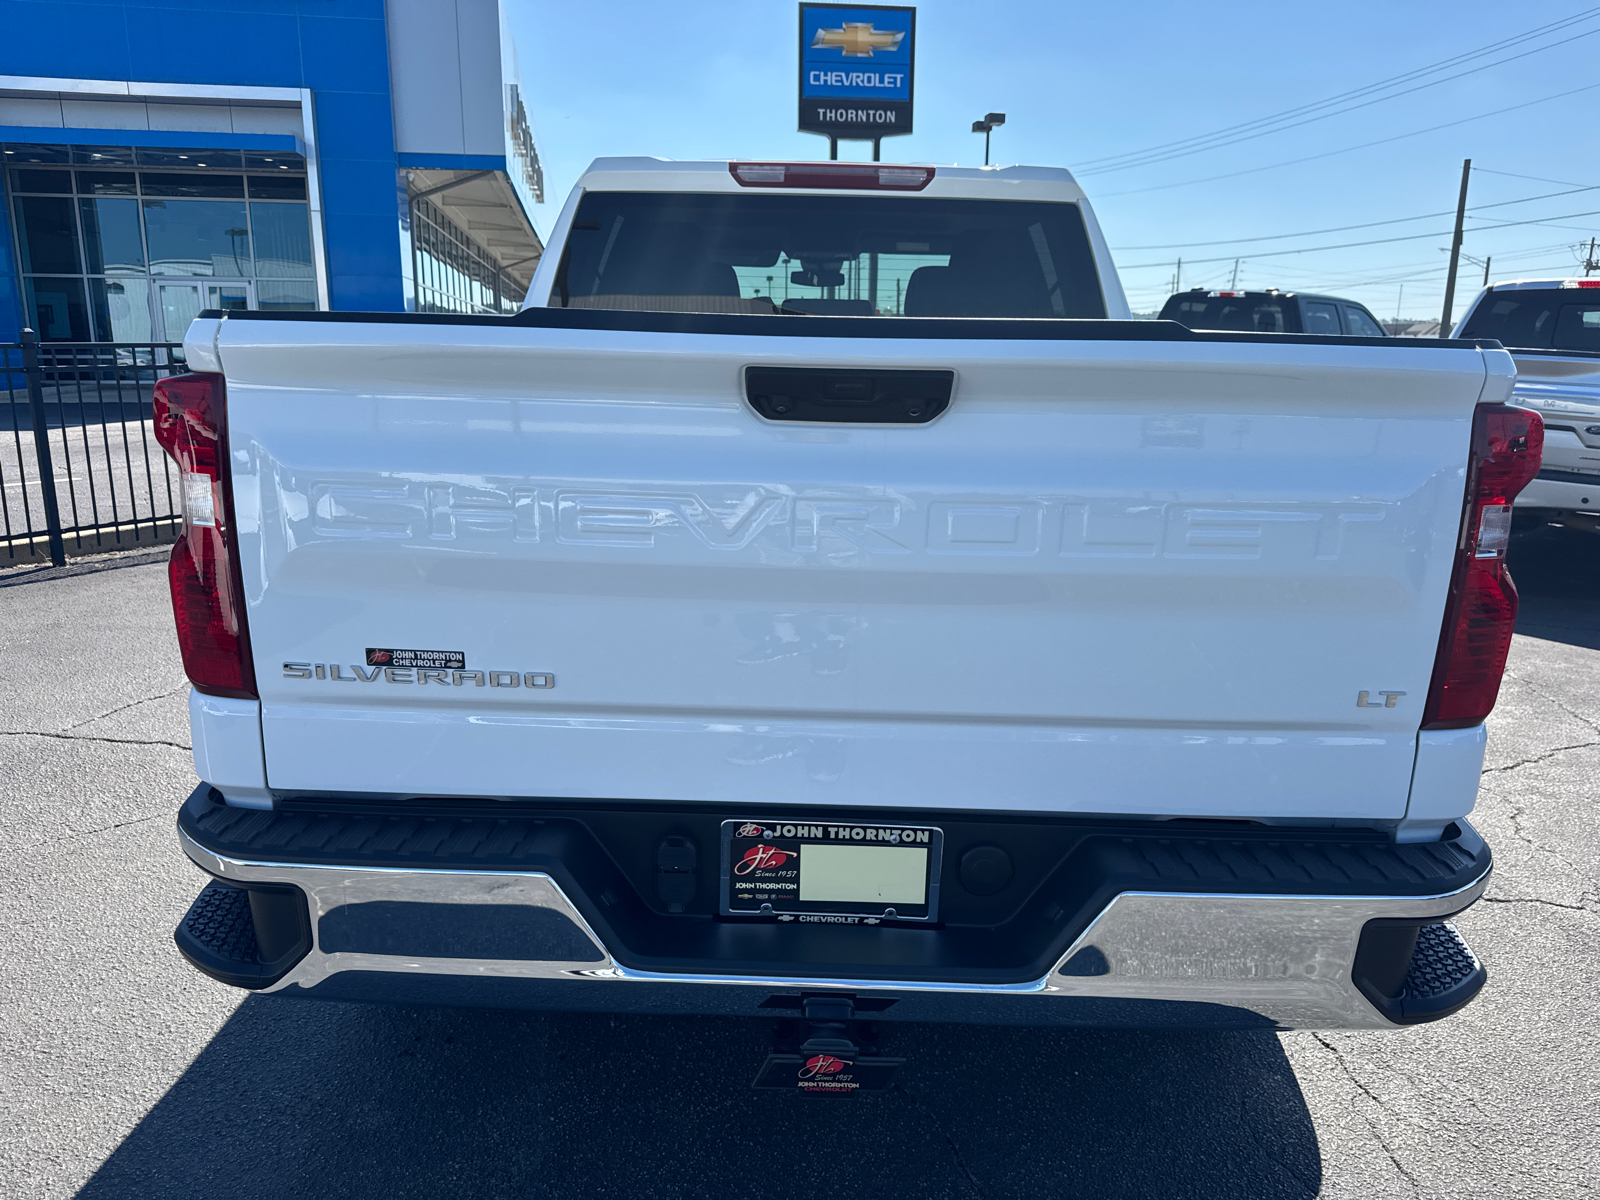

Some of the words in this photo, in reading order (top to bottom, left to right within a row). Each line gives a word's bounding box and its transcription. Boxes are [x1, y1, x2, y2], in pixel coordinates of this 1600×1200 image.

[809, 71, 904, 88] CHEVROLET
[817, 108, 896, 123] THORNTON
[311, 478, 1386, 561] CHEVROLET
[393, 651, 415, 659] JOHN
[417, 652, 463, 660] THORNTON
[393, 659, 446, 667] CHEVROLET
[282, 661, 555, 689] SILVERADO
[1356, 690, 1407, 708] LT
[773, 825, 823, 838] JOHN
[778, 870, 797, 878] 1957
[799, 915, 860, 924] CHEVROLET
